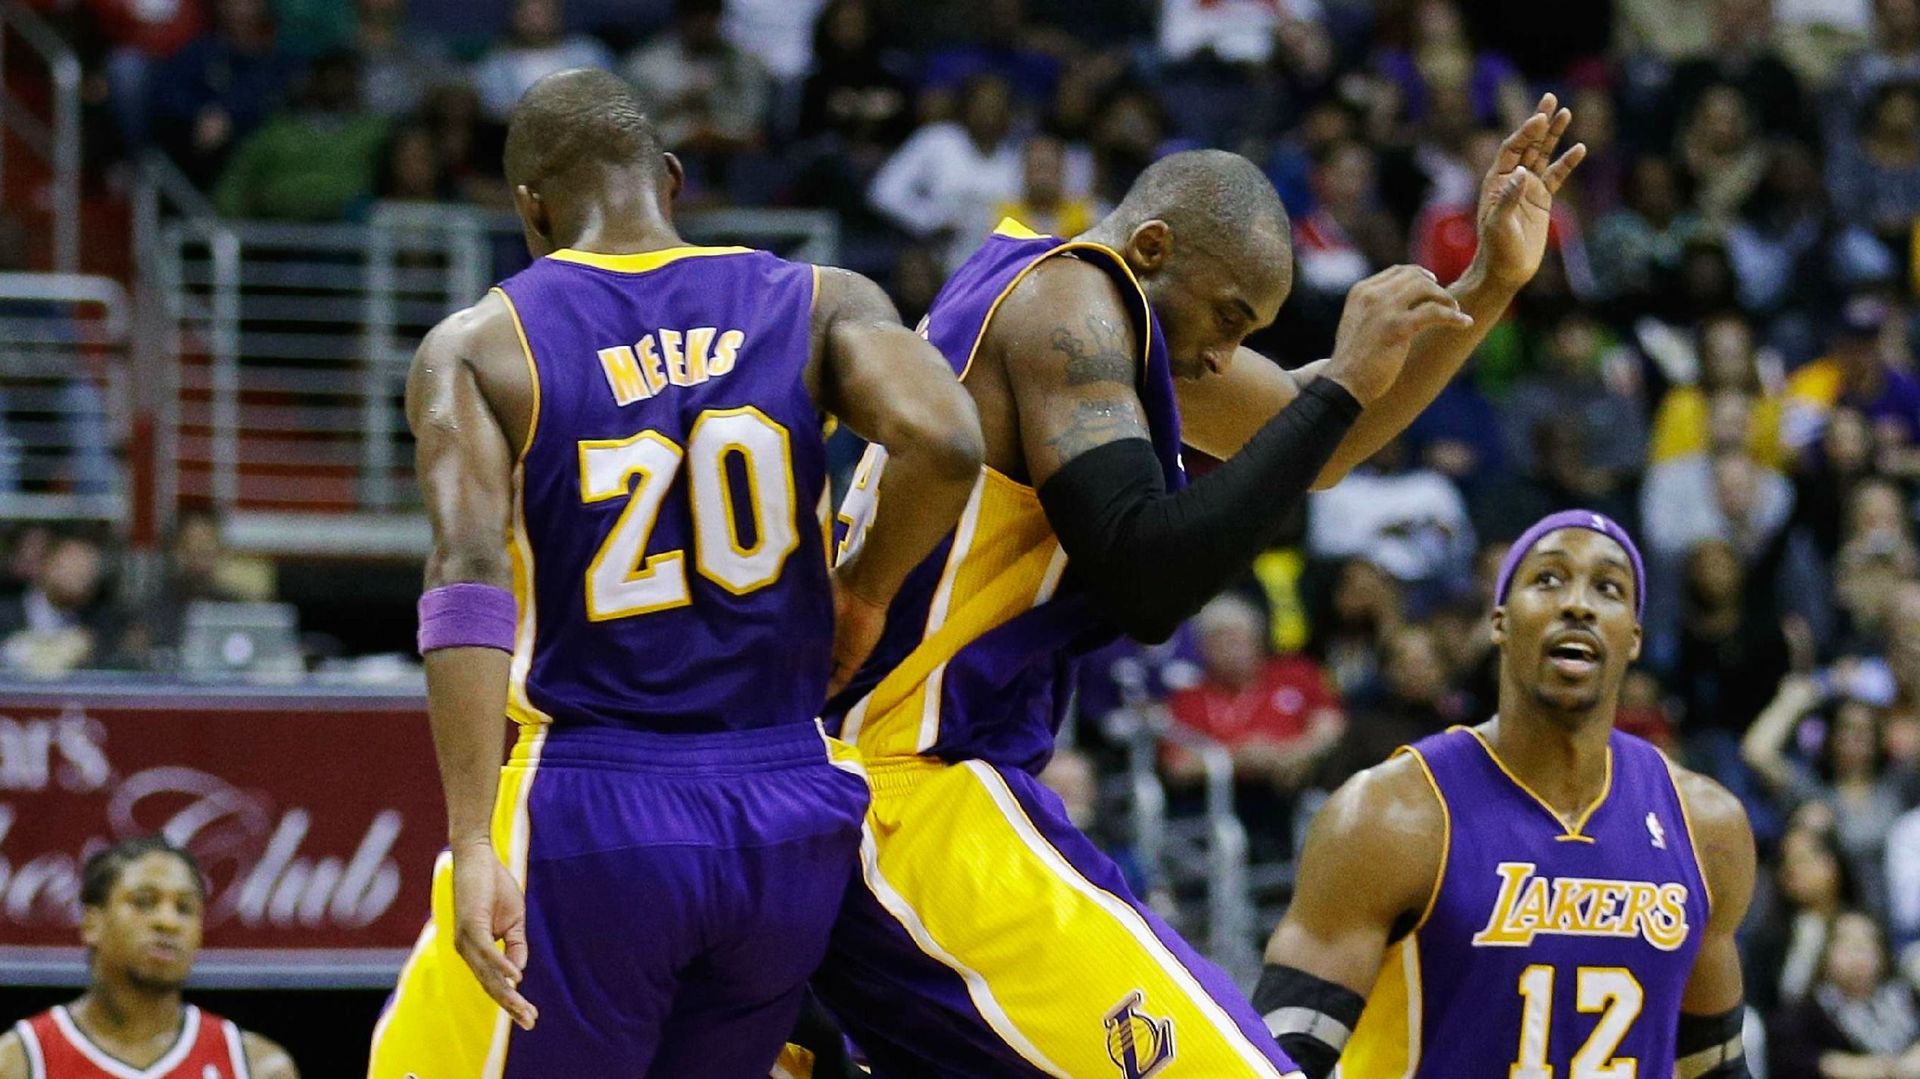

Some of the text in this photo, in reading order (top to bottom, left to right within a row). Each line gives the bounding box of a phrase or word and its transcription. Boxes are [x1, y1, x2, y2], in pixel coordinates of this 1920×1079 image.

[597, 326, 745, 407] MEEKS
[577, 405, 800, 622] 20
[1472, 862, 1690, 951] LAKERS
[1508, 964, 1644, 1079] 12
